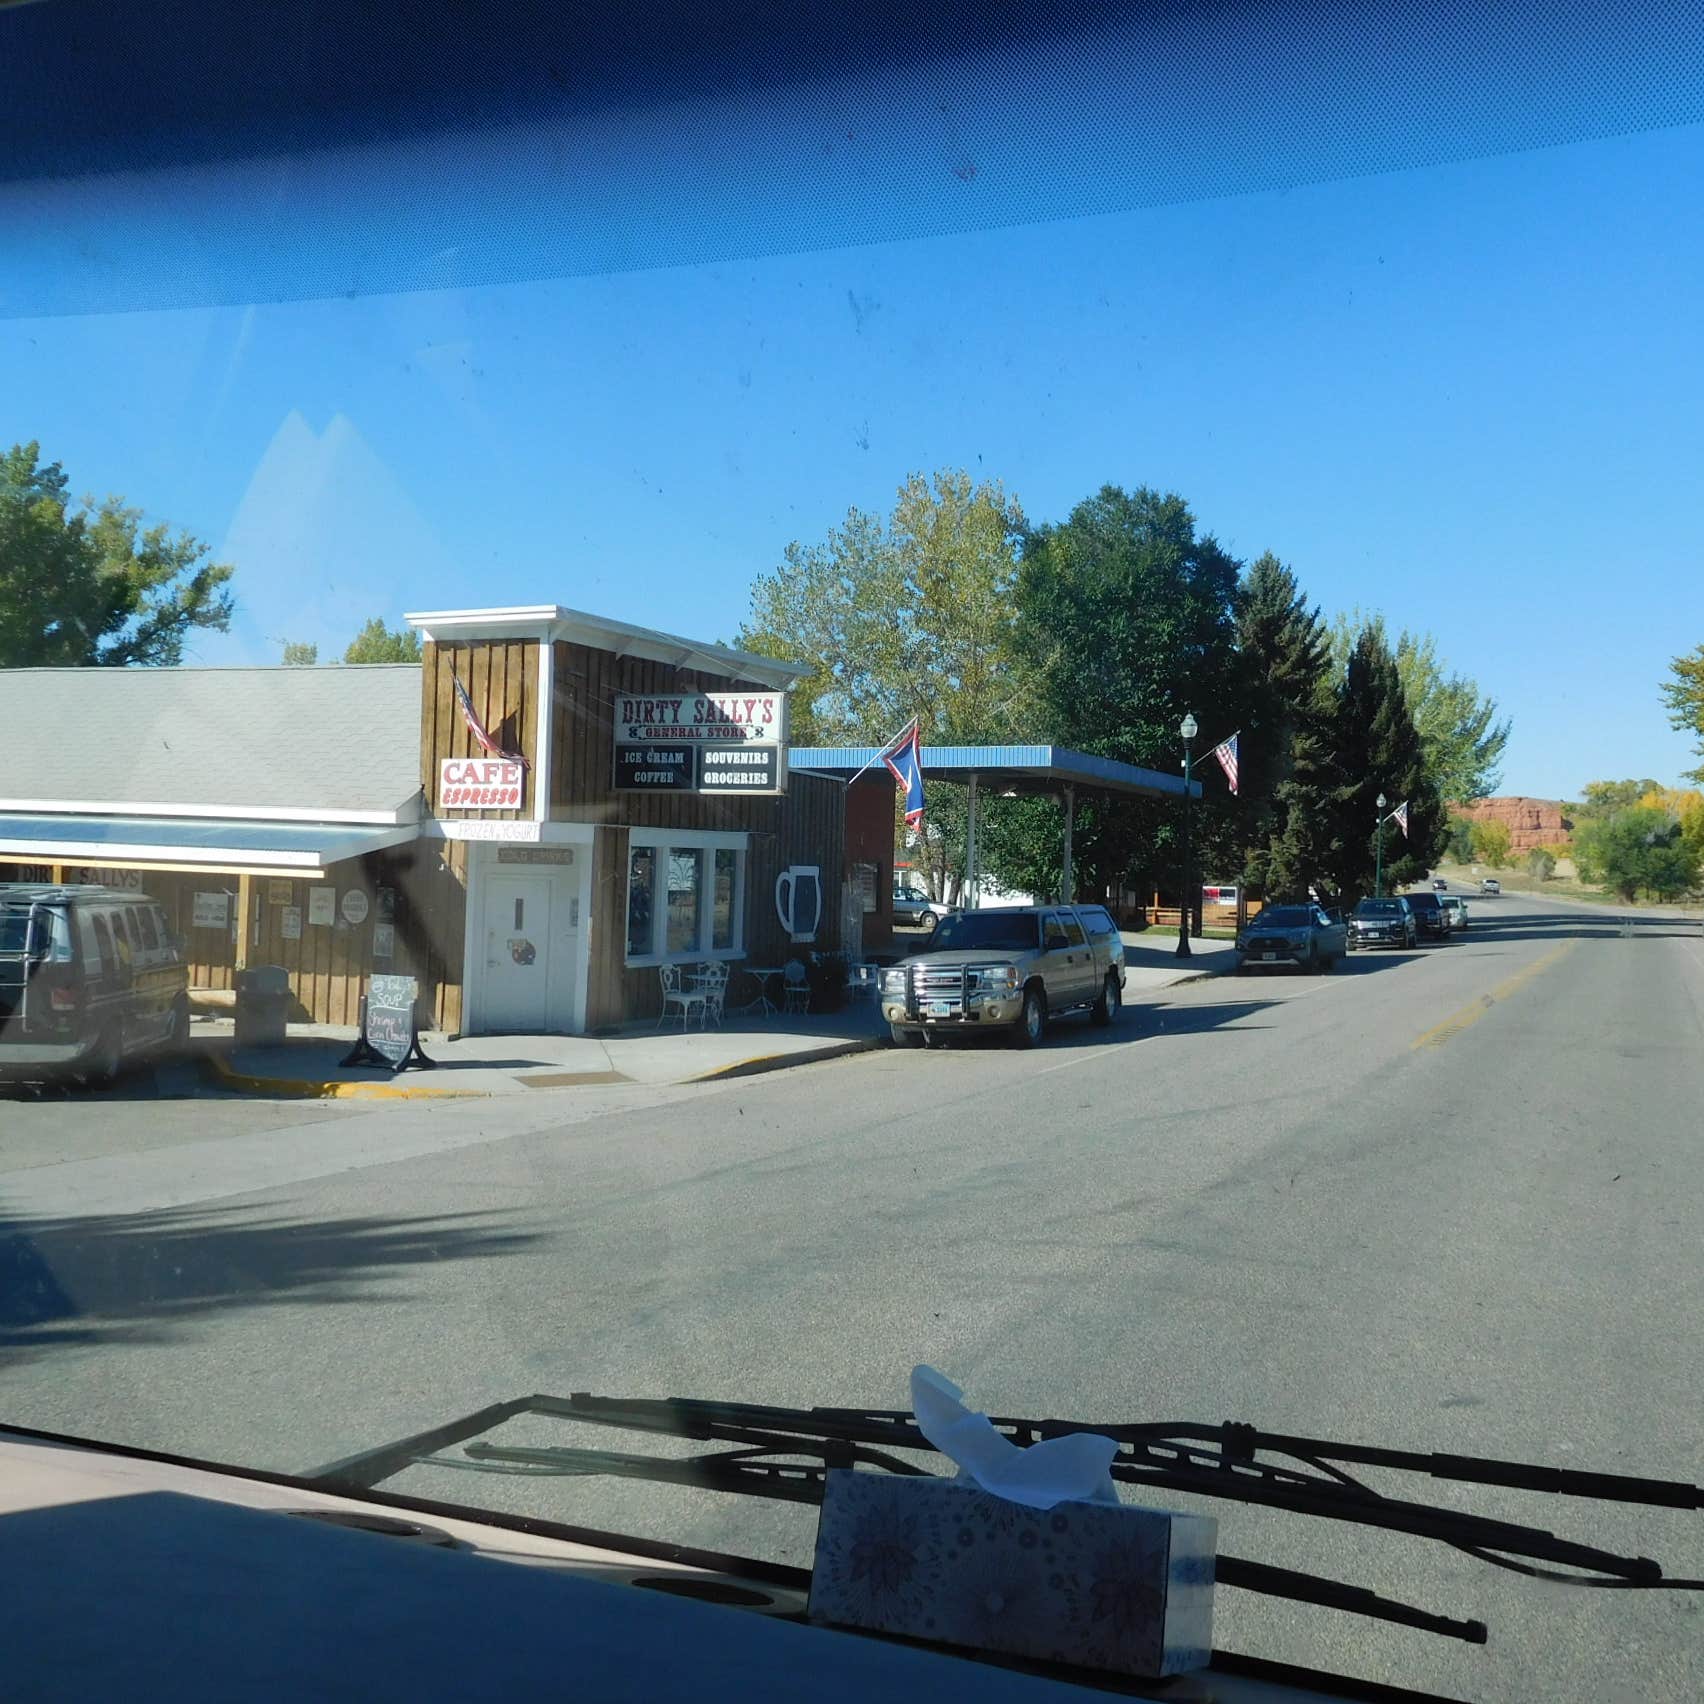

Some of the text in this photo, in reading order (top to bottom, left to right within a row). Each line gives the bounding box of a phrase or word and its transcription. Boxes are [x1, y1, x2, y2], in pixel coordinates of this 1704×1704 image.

[622, 699, 773, 724] DIRTY SALLY'S
[645, 727, 747, 738] GENERAL STORE
[625, 752, 684, 764] ICE CREAM
[705, 752, 768, 764] SOUVENIRS
[443, 762, 519, 785] CAFE
[634, 772, 674, 783] COFFEE
[704, 772, 768, 785] GROCERIES
[442, 787, 519, 805] ESPRESSO
[459, 822, 495, 839] FROZEN
[503, 823, 538, 841] YOGURT
